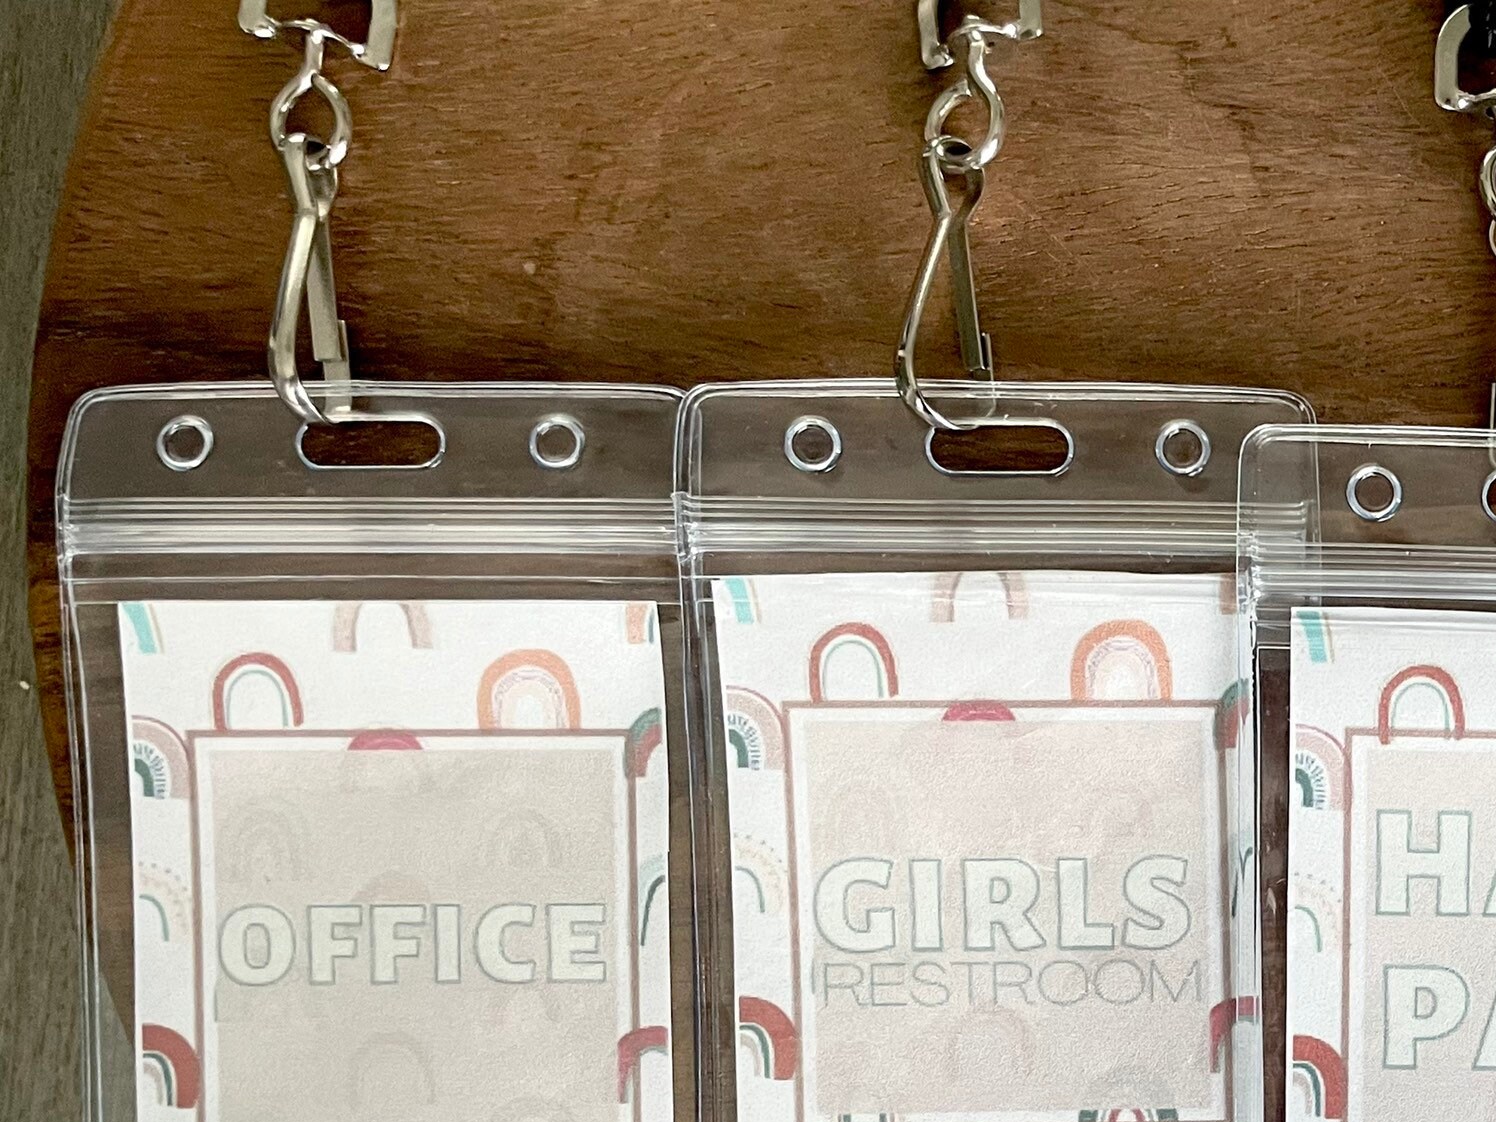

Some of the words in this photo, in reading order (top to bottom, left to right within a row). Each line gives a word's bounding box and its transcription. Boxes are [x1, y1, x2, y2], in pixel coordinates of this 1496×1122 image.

[219, 902, 606, 987] OFFICE
[813, 856, 1192, 953] GIRLS
[824, 957, 1199, 1008] RESTROOM
